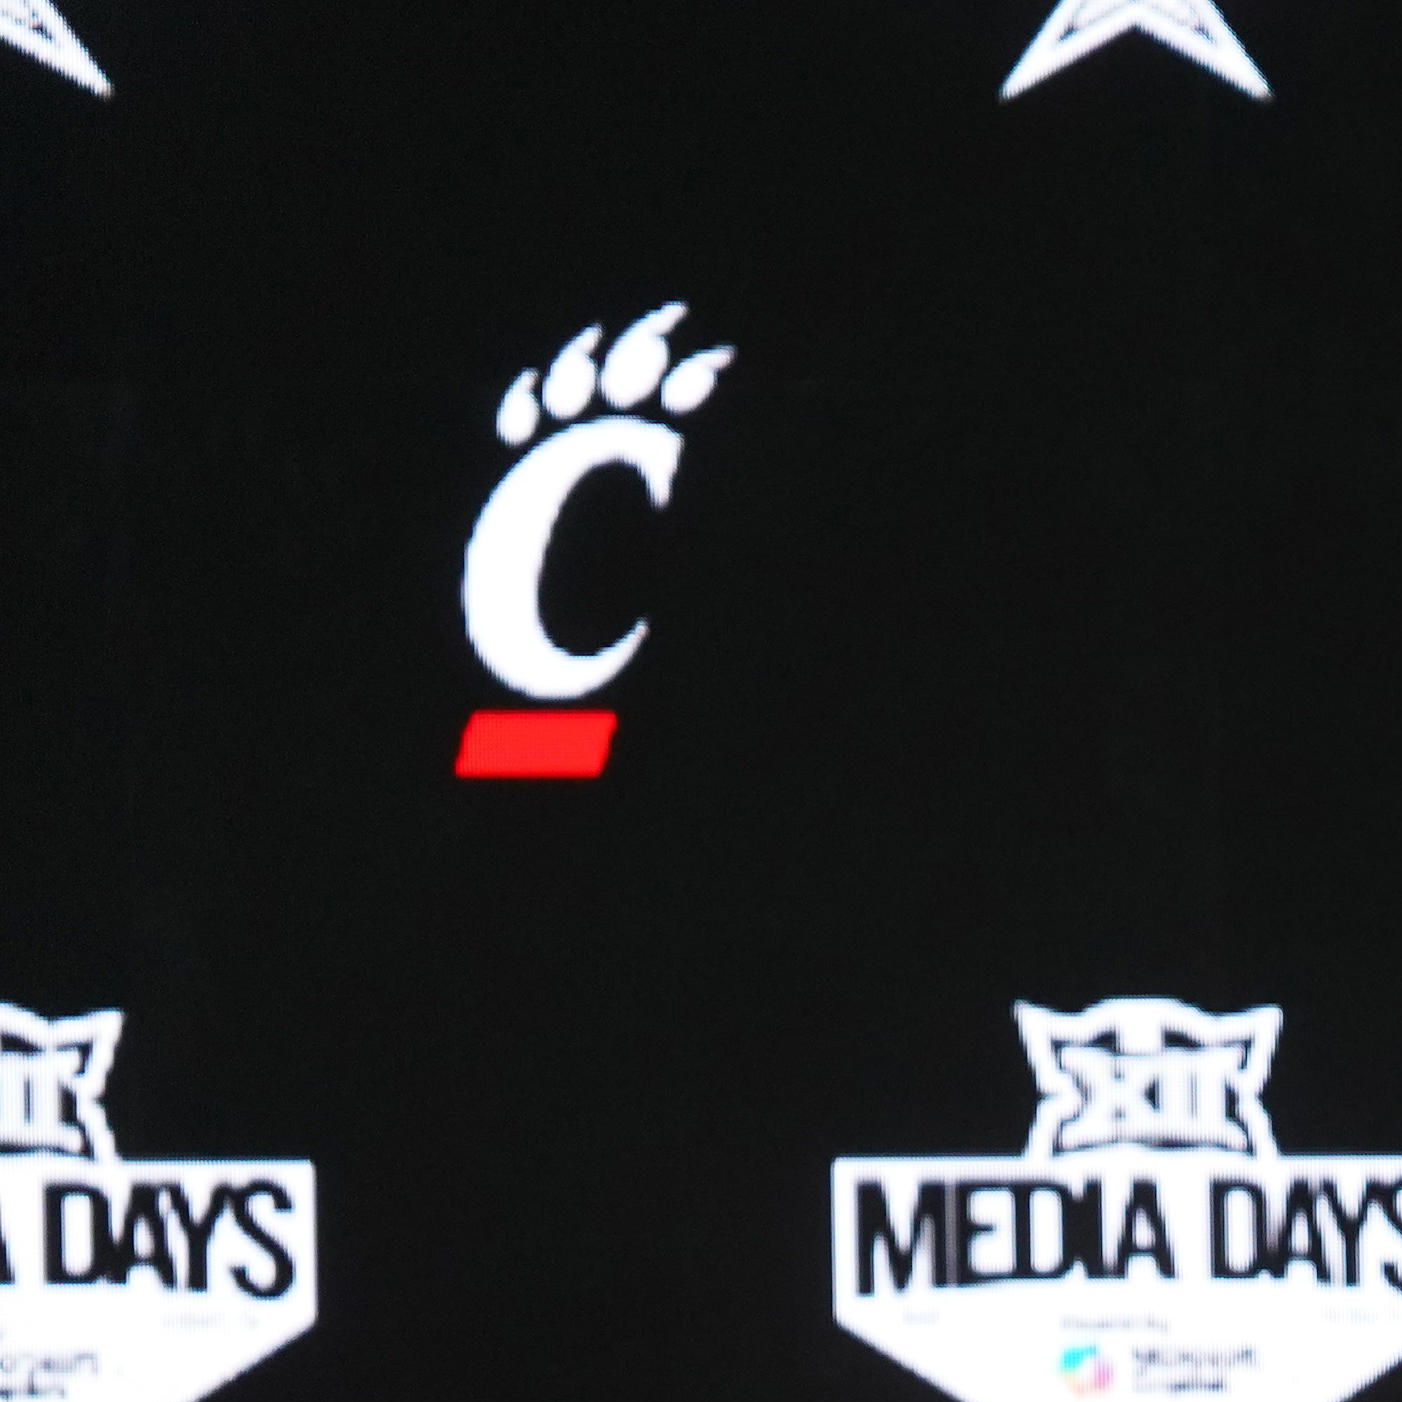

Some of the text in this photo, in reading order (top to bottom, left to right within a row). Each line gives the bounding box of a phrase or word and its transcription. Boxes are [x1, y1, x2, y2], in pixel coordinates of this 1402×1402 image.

[462, 414, 686, 702] C
[43, 1178, 297, 1300] DAYS
[855, 1178, 1178, 1299] MEDIA
